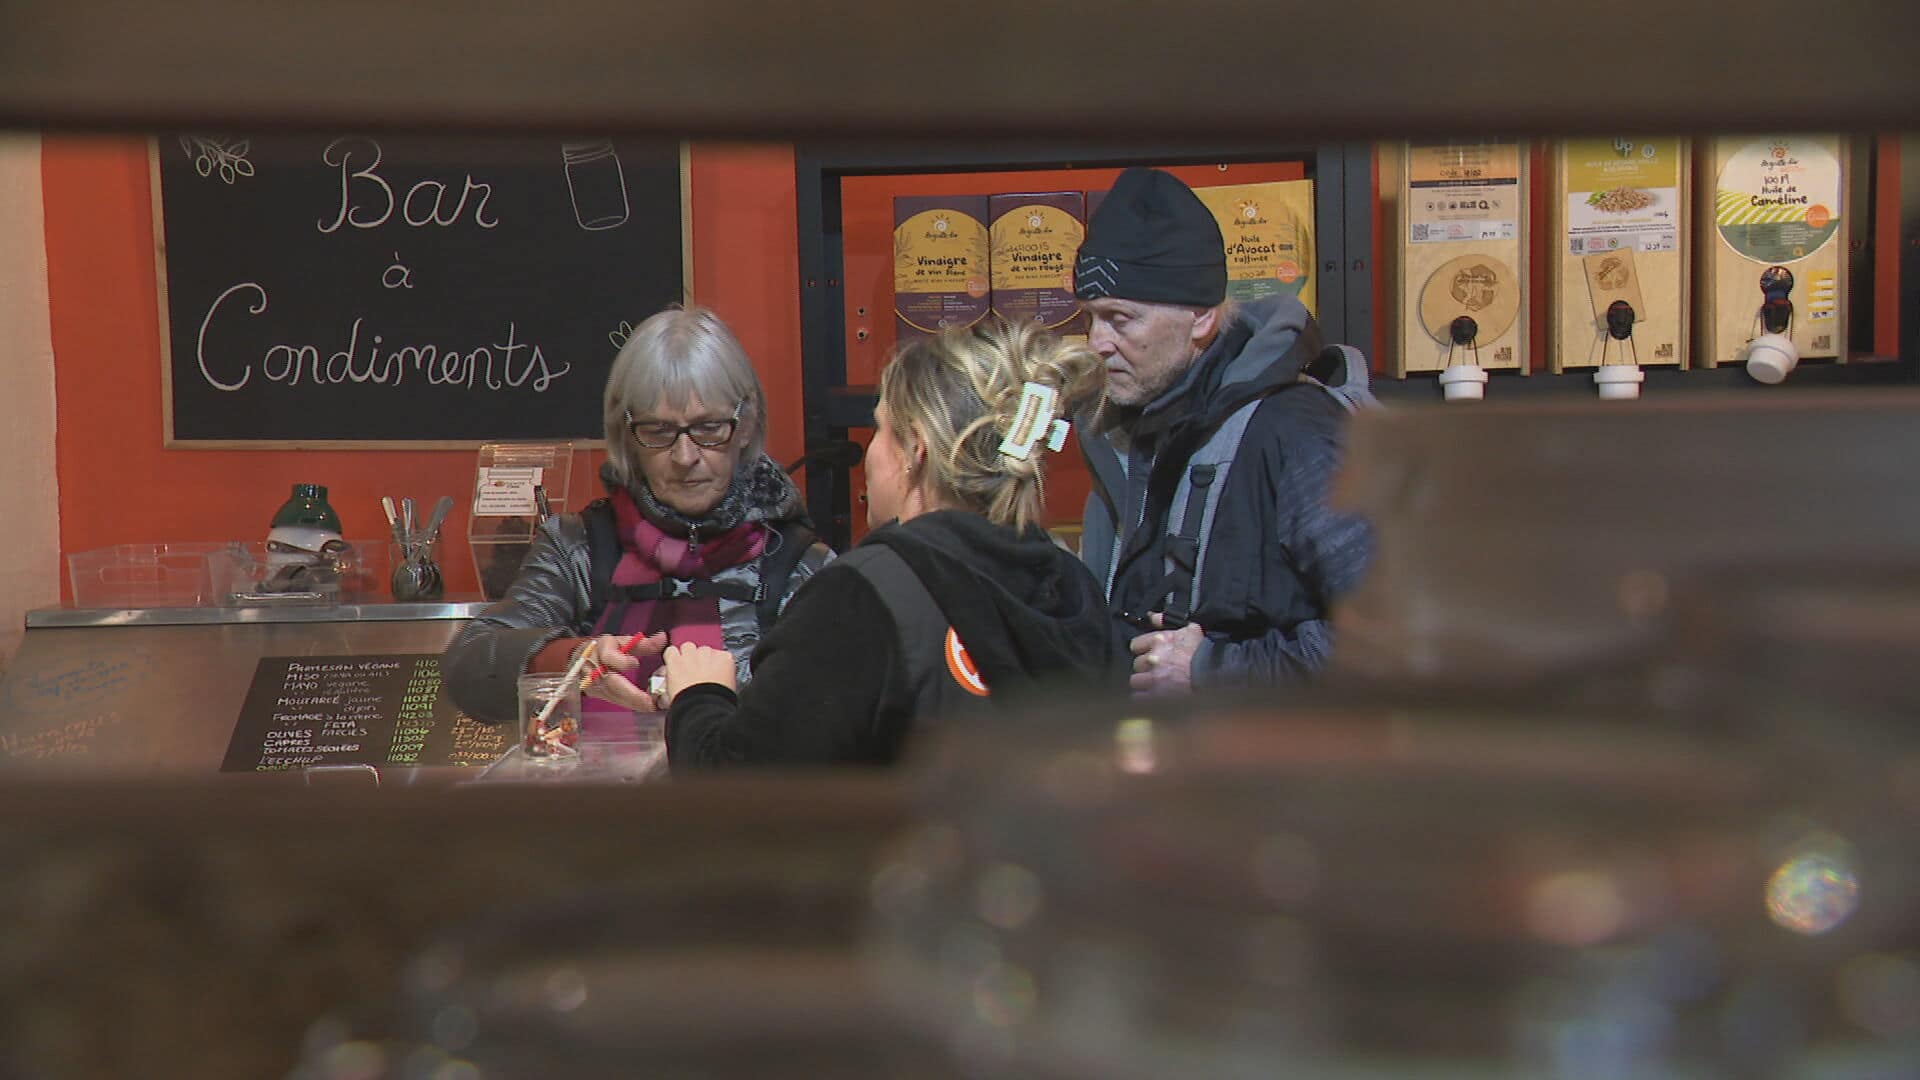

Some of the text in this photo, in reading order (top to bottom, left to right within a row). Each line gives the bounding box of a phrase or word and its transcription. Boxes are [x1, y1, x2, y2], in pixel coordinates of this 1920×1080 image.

[317, 137, 498, 232] Bar
[1762, 186, 1783, 194] Huile
[1226, 243, 1276, 254] d'Avocat
[917, 256, 968, 269] Vinaigre
[1011, 251, 1063, 264] Vinaigre
[382, 251, 413, 288] à
[198, 283, 570, 391] Condiments
[286, 672, 320, 681] MISO
[283, 681, 318, 690] MAYO
[324, 720, 356, 728] FETA
[266, 729, 313, 739] OLIVES
